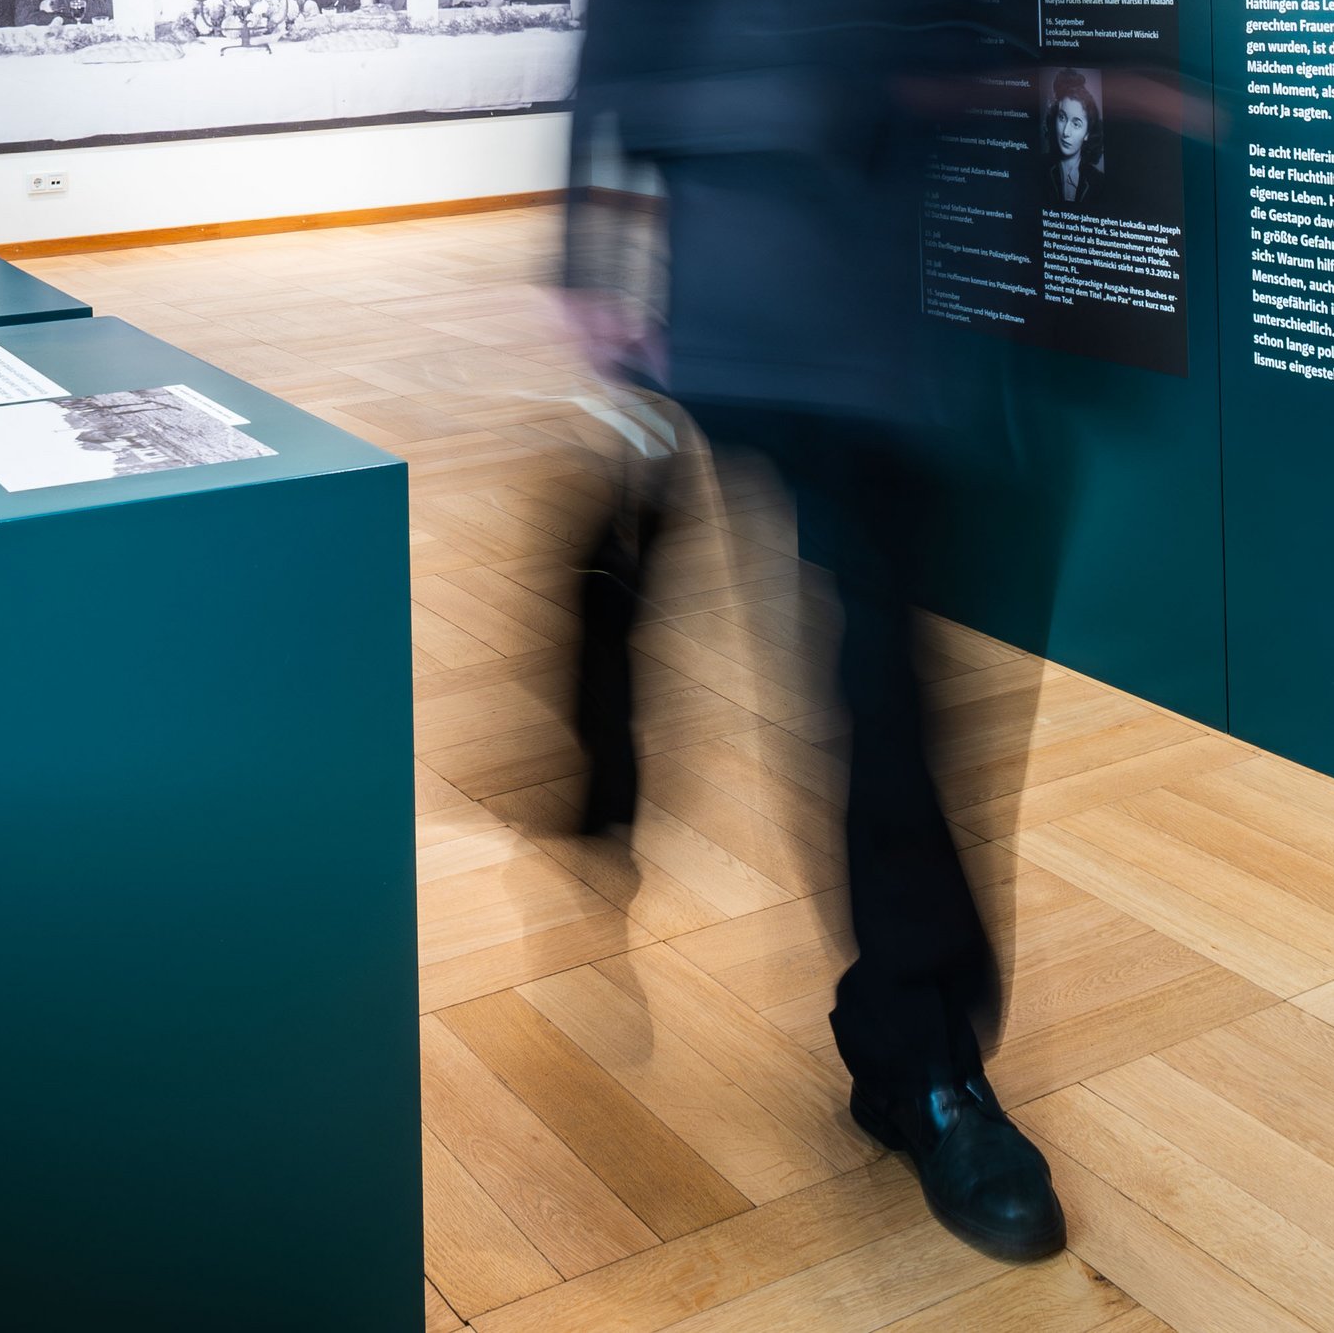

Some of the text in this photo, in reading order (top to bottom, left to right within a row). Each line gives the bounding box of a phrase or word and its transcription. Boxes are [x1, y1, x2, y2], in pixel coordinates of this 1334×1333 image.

[1070, 29, 1094, 38] Justman
[1094, 29, 1118, 38] heiratet
[1249, 143, 1266, 157] Die
[1267, 145, 1292, 160] acht
[1065, 224, 1080, 232] nach
[1080, 224, 1093, 234] New
[1093, 226, 1109, 236] York.
[1109, 228, 1119, 238] Sie
[1119, 229, 1153, 242] bekommen
[1153, 236, 1168, 244] zwei
[1254, 351, 1287, 371] lismus
